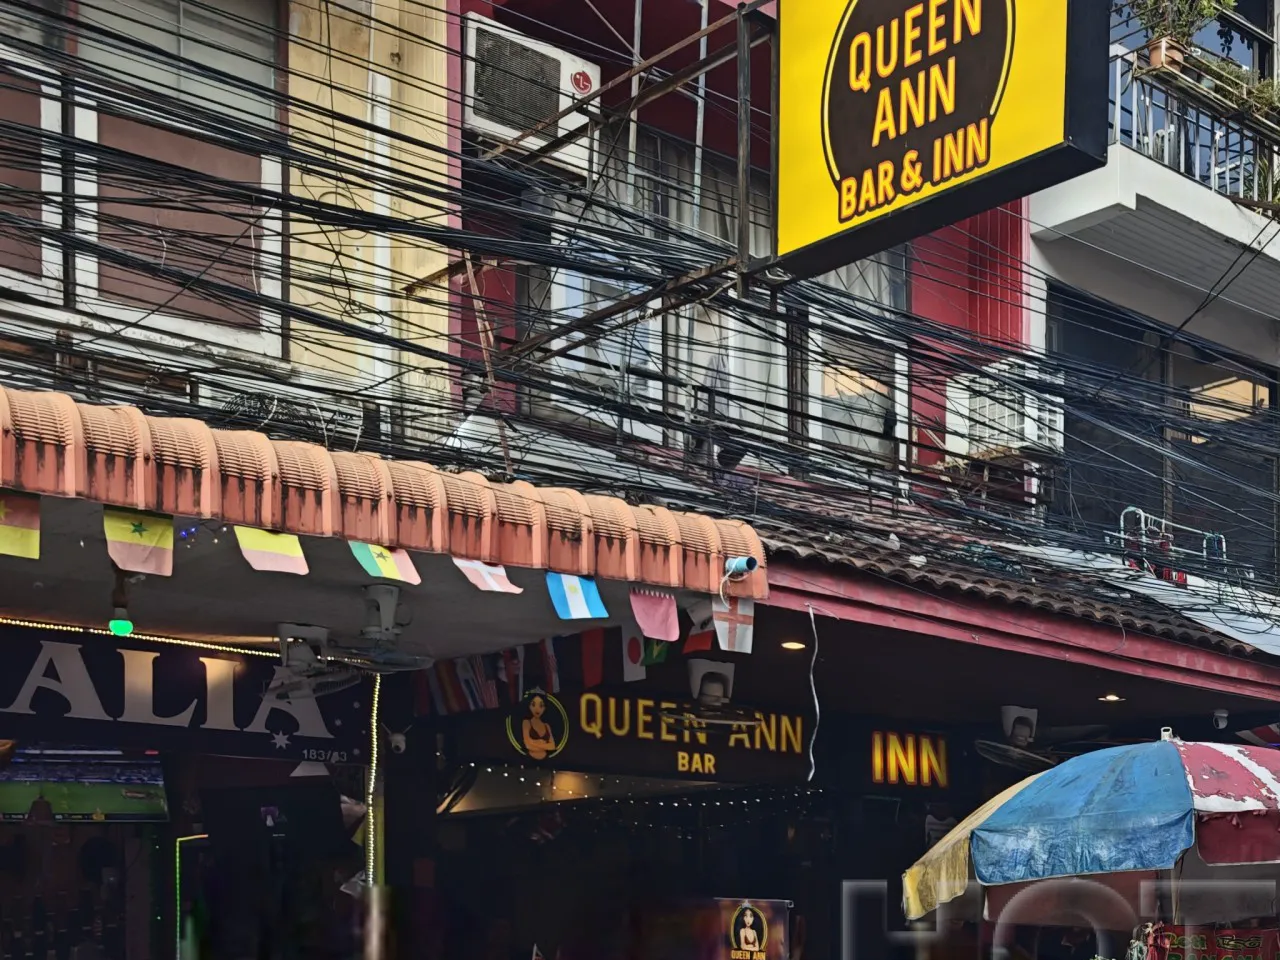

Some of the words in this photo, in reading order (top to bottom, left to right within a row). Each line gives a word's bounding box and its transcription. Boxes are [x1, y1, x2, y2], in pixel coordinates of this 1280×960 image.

[848, 0, 983, 94] QUEEN
[871, 55, 956, 148] ANN
[839, 160, 895, 221] BAR
[901, 149, 924, 190] &
[932, 118, 990, 184] INN
[578, 692, 708, 746] QUEEN
[729, 710, 804, 754] ANN
[676, 750, 718, 775] BAR
[871, 728, 949, 788] INN
[731, 949, 752, 960] QUEEN
